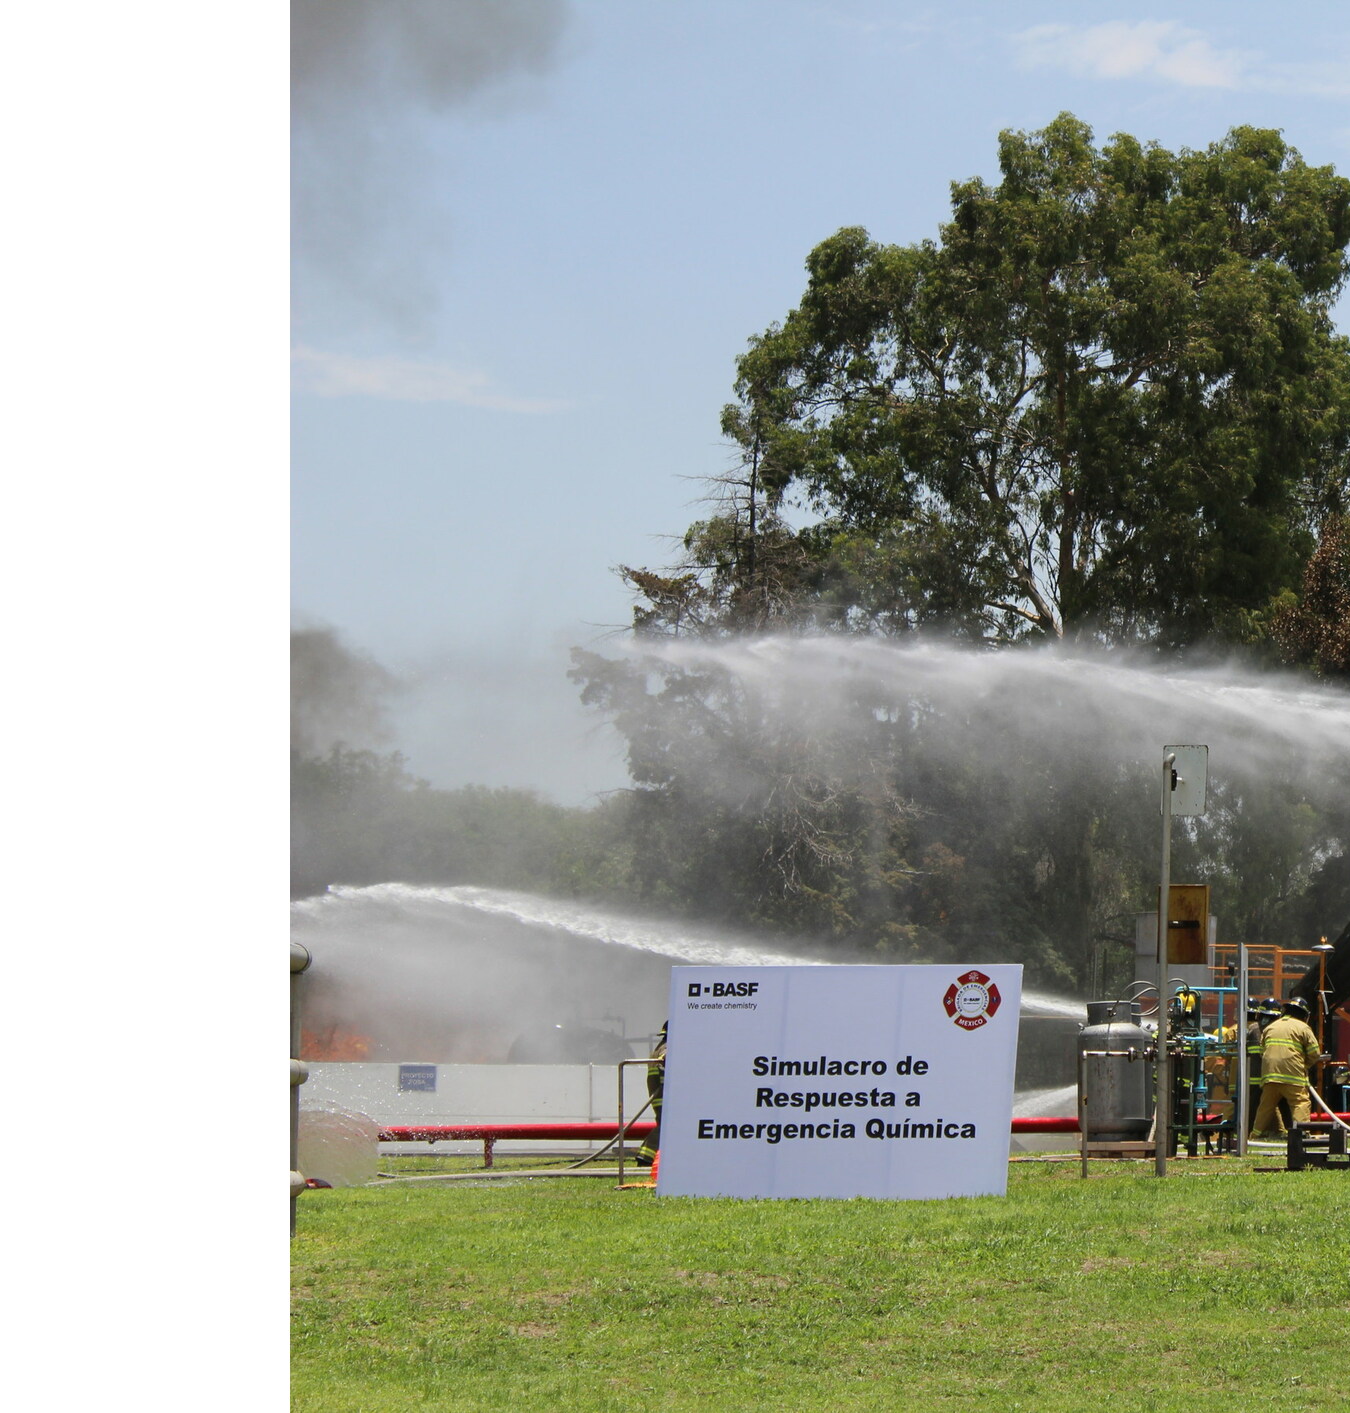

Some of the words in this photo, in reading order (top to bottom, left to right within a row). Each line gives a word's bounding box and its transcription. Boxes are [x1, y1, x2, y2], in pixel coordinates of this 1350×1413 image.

[713, 983, 759, 996] BASF
[687, 1002, 699, 1010] We
[701, 1002, 723, 1010] create
[724, 1002, 758, 1011] chemistry
[752, 1056, 887, 1076] Simulacro
[896, 1056, 929, 1076] de
[756, 1087, 896, 1112] Respuesta
[905, 1091, 921, 1107] a
[698, 1119, 856, 1144] Emergencia
[865, 1118, 976, 1140] Química
